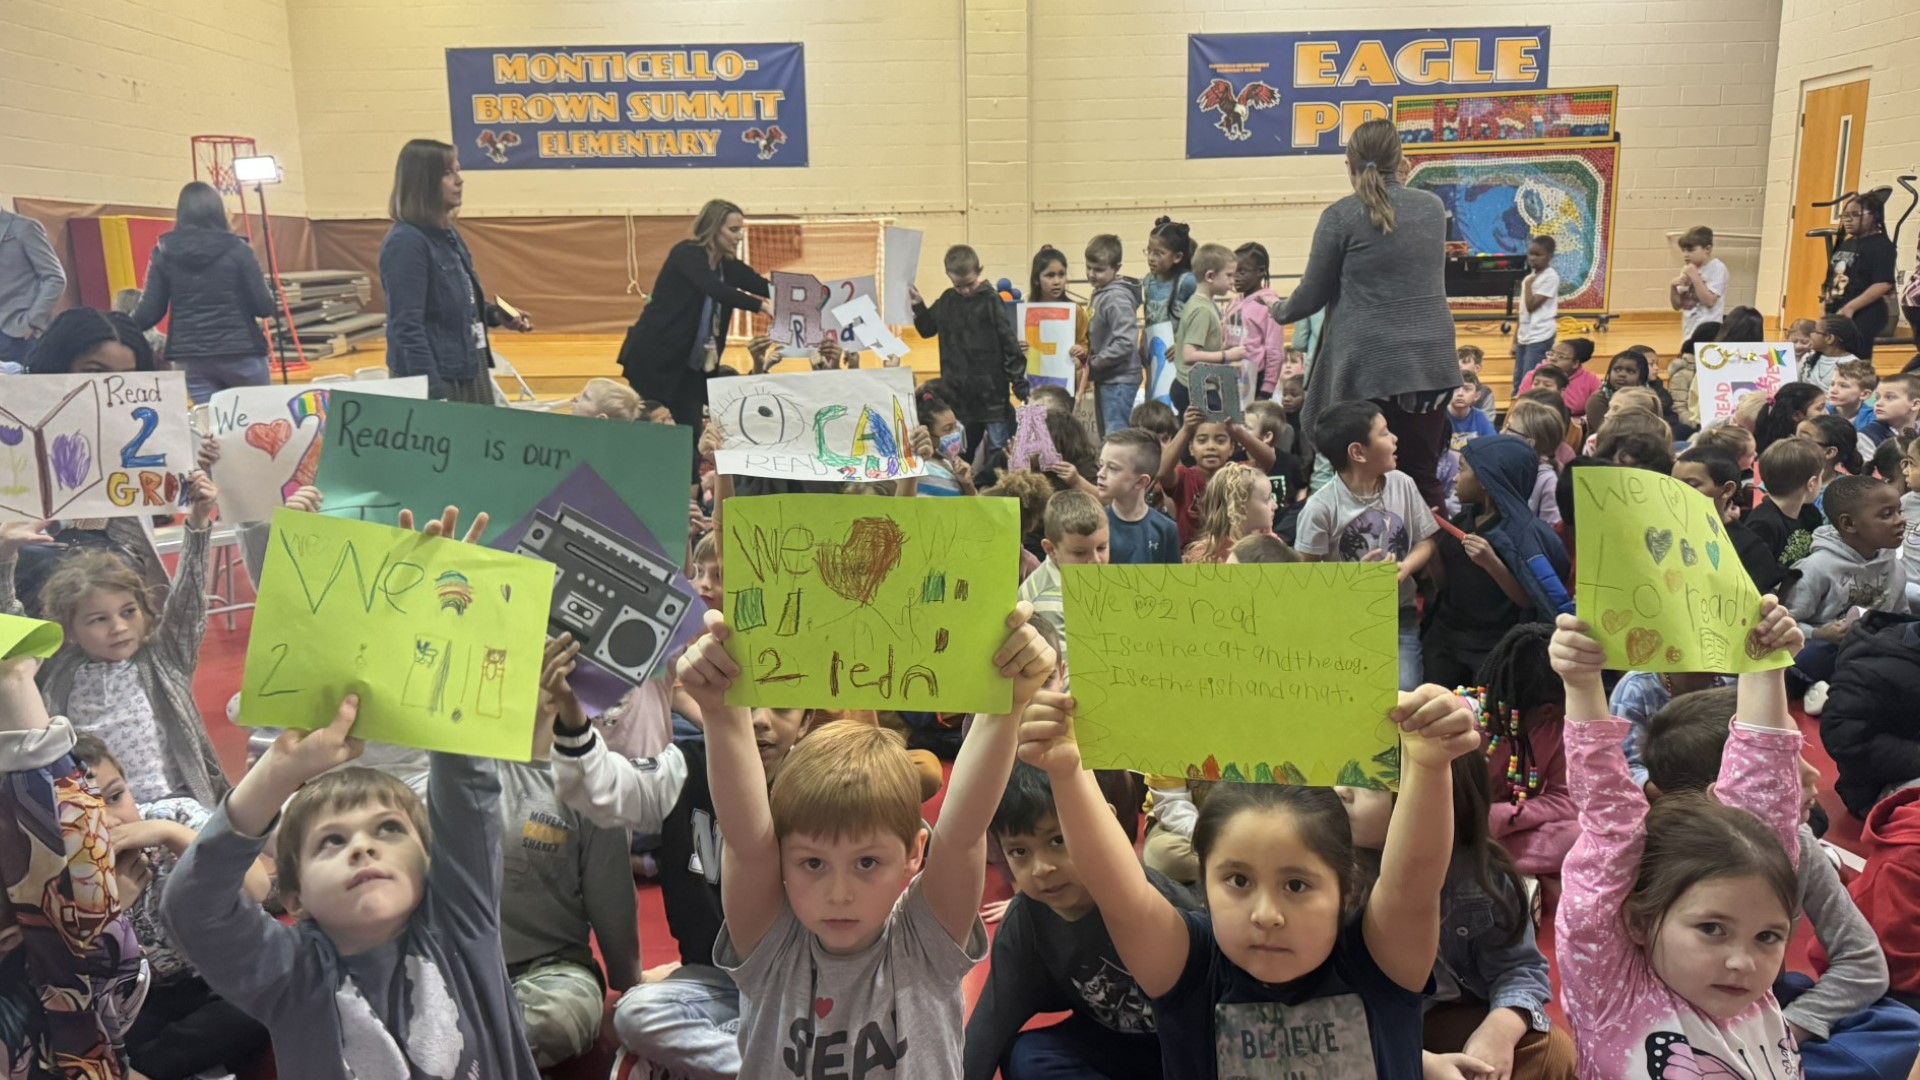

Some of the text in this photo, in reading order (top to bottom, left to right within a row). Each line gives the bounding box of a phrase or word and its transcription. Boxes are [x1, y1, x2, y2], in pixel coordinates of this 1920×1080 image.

[493, 50, 758, 84] MONTICELLO-
[1293, 37, 1541, 87] EAGLE
[473, 90, 785, 124] BROWN SUMMIT
[538, 129, 721, 157] ELEMENTARY
[105, 376, 162, 408] Read
[214, 396, 250, 434] We
[120, 406, 167, 468] 2
[338, 400, 572, 473] Reading is our
[812, 393, 927, 475] CAN
[1007, 404, 1063, 473] A
[1578, 469, 1648, 511] We
[280, 528, 425, 614] We
[733, 521, 814, 583] We
[1578, 533, 1663, 627] to
[1084, 585, 1122, 622] We
[1158, 597, 1178, 621] 2
[1188, 597, 1260, 635] read
[258, 643, 305, 697] 2
[755, 647, 809, 685] 2
